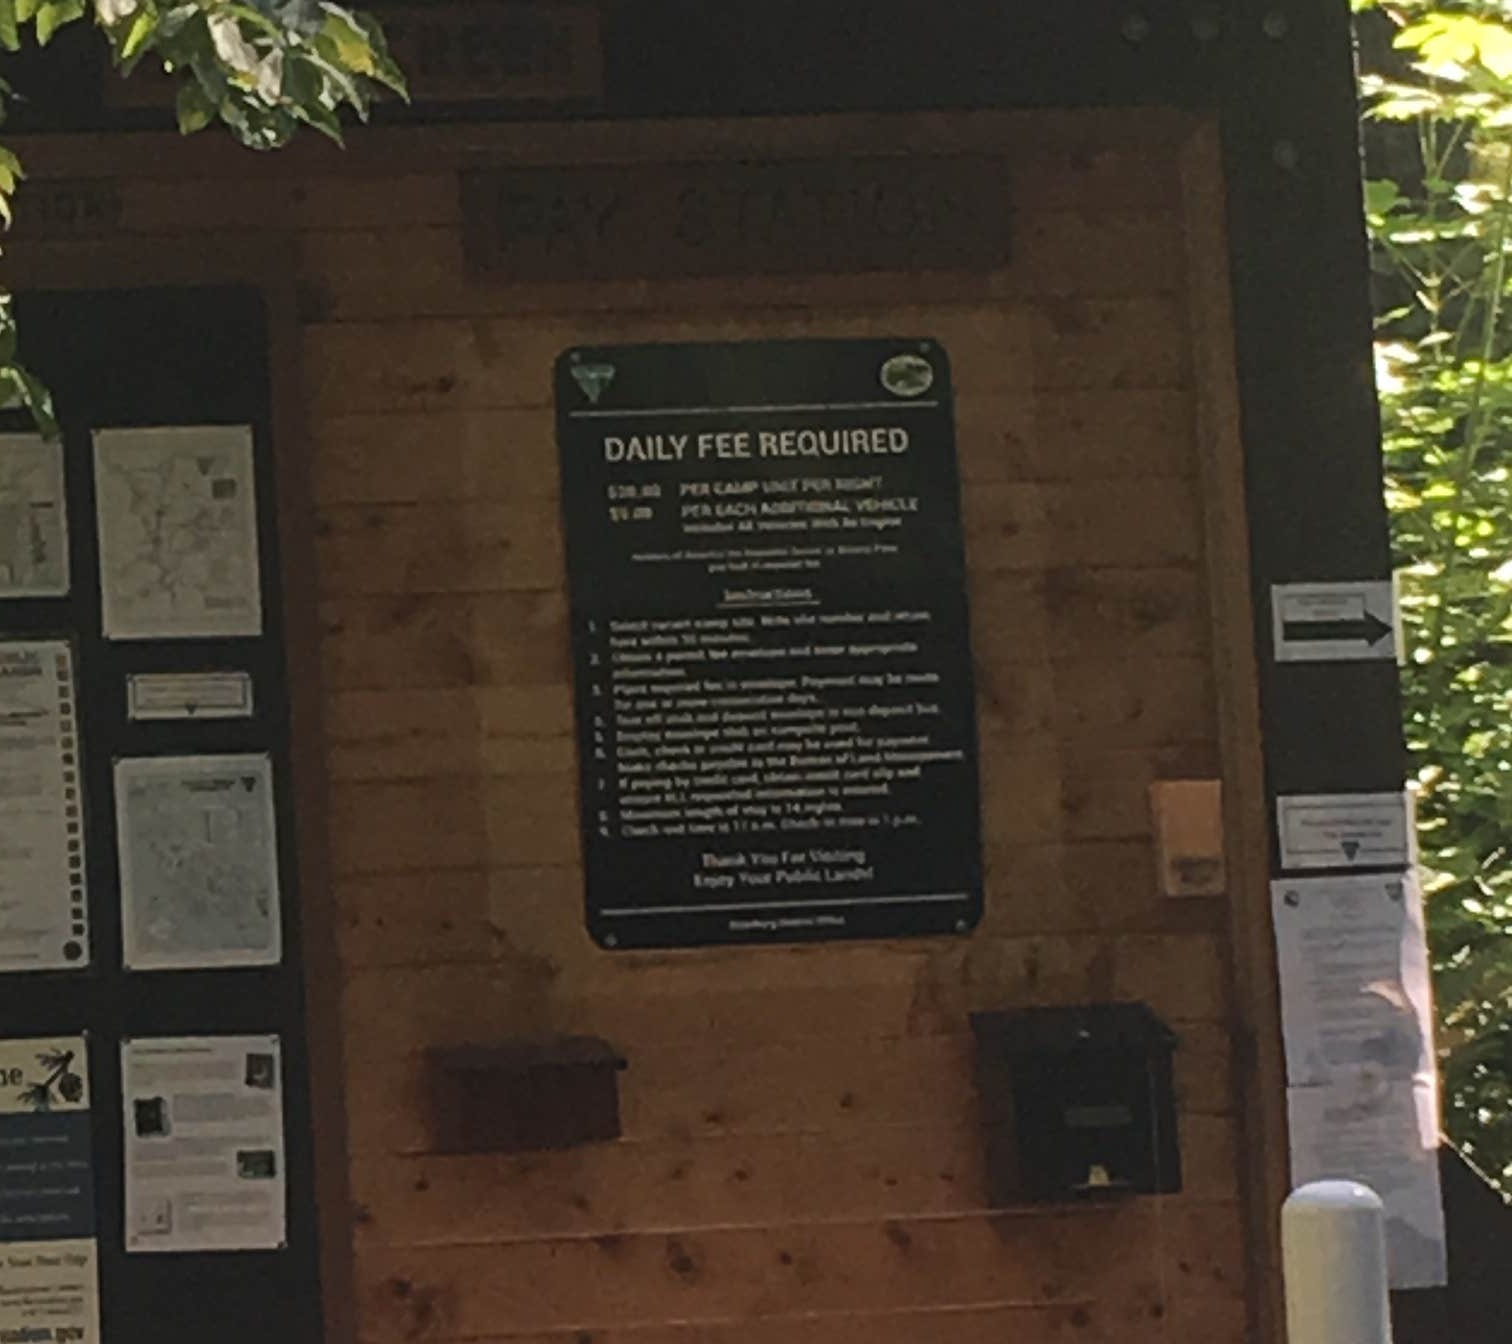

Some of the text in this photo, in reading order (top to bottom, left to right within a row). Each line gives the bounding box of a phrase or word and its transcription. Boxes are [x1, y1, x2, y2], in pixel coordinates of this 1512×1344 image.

[604, 427, 909, 462] DAILY FEE REQUIRED
[679, 481, 711, 497] PER
